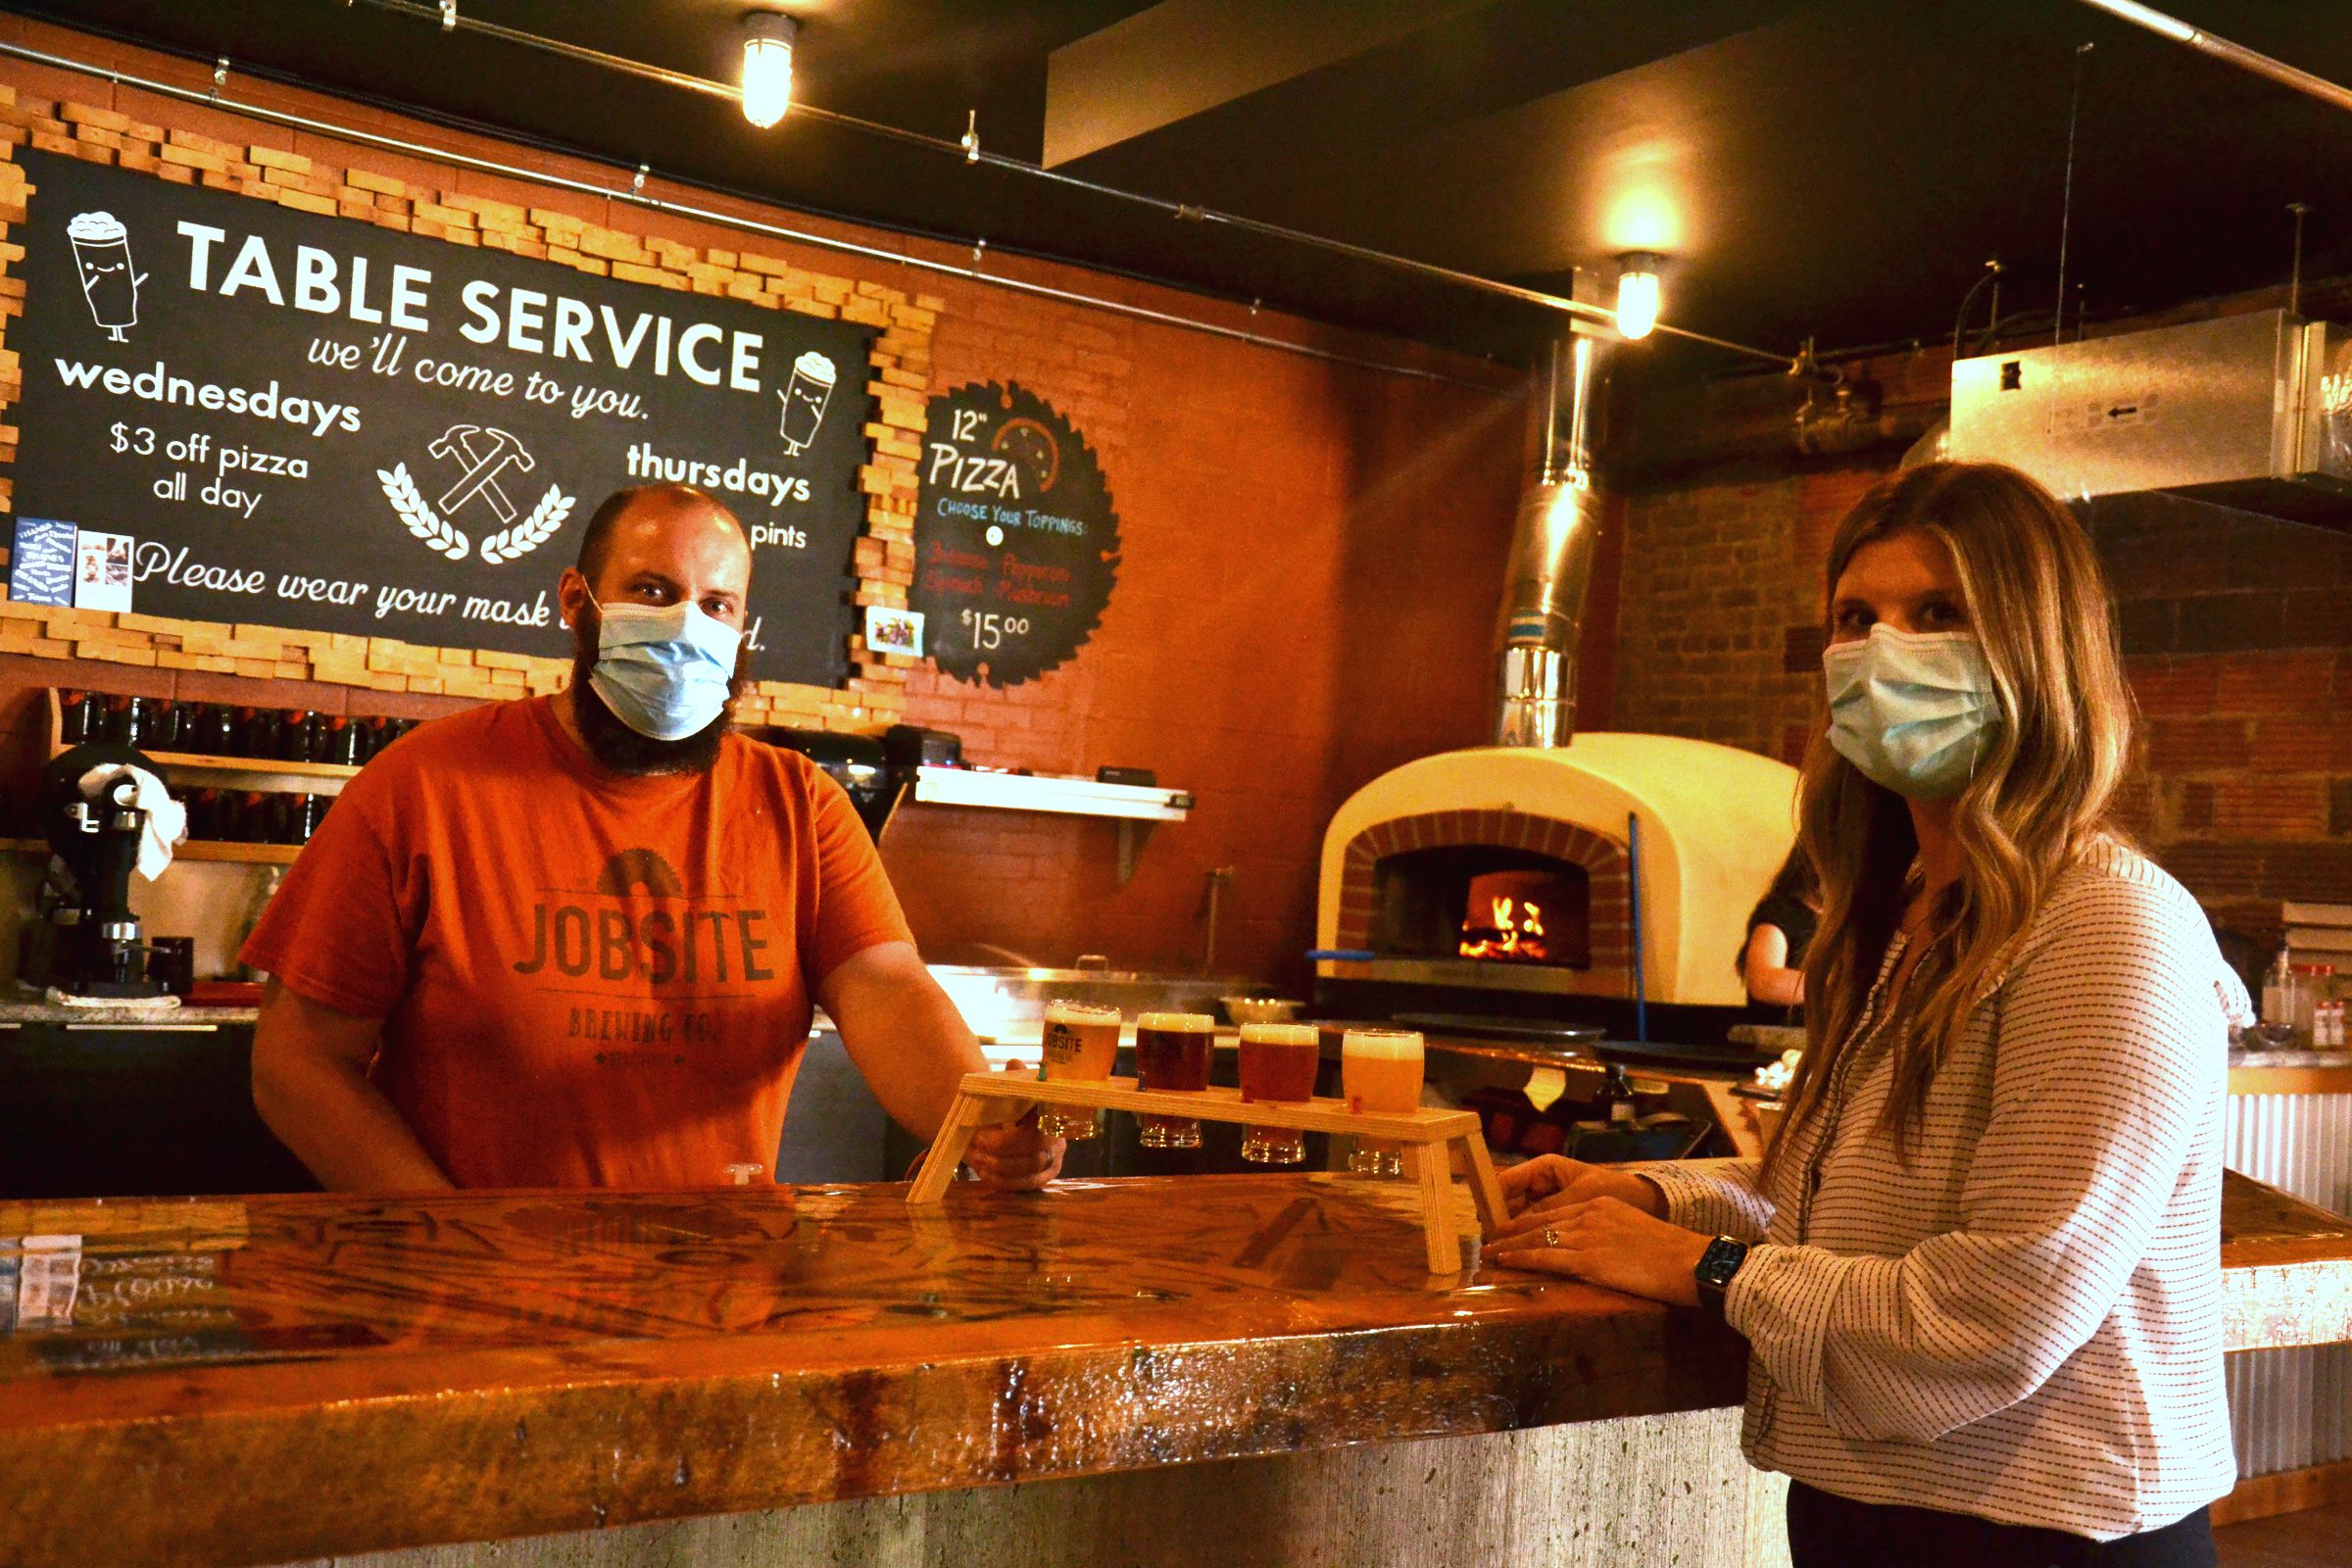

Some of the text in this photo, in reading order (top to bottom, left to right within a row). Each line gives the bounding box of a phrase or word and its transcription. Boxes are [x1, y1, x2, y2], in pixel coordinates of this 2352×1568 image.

[176, 220, 763, 393] TABLE SERVICE
[54, 358, 363, 437] wednesdays
[307, 331, 650, 421] we'll come to you.
[110, 420, 310, 480] $3 off pizza
[626, 441, 812, 508] thursdays
[929, 442, 1020, 501] PIZZA
[153, 470, 263, 519] all day
[937, 497, 988, 521] CHOOSE
[992, 505, 1022, 526] YOUR
[750, 520, 808, 552] pints
[132, 540, 551, 629] Please wear your mask
[513, 903, 775, 984] JOBSITE
[567, 1005, 672, 1044] BREWING
